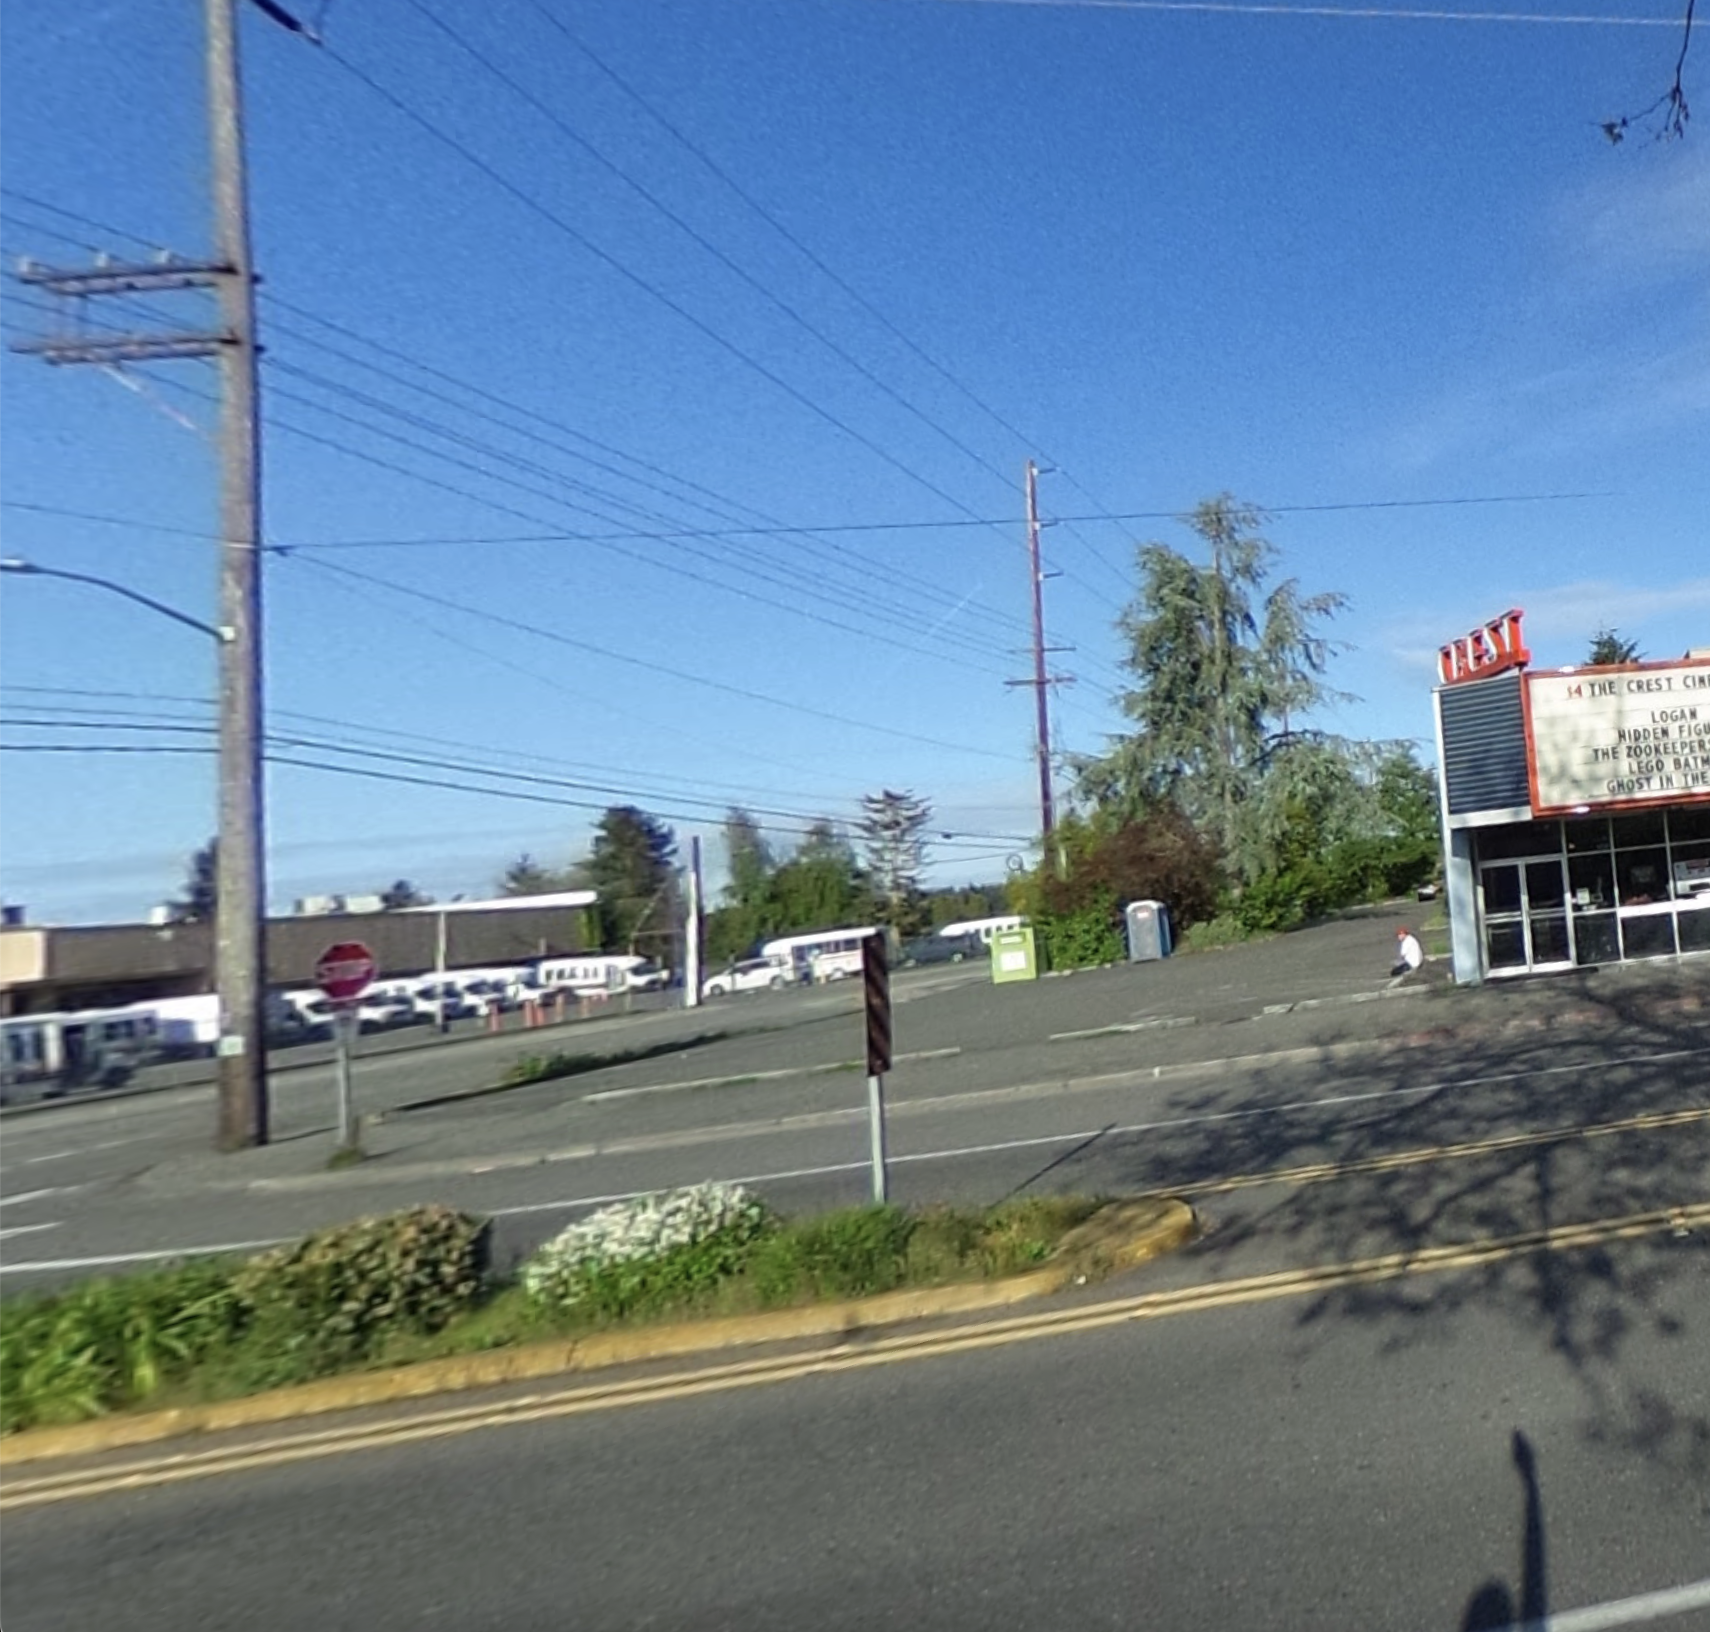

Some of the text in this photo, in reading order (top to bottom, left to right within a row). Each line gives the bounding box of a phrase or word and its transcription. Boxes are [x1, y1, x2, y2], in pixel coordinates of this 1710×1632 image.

[1589, 681, 1617, 698] THE
[1627, 676, 1673, 693] CREST
[1651, 707, 1698, 724] LOGAN
[1618, 726, 1670, 743] HIDDEN
[1593, 746, 1619, 762] THE
[1629, 759, 1665, 775] LEGO
[1607, 775, 1652, 794] GHOST
[1659, 773, 1674, 788] IN
[1684, 770, 1709, 786] THE
